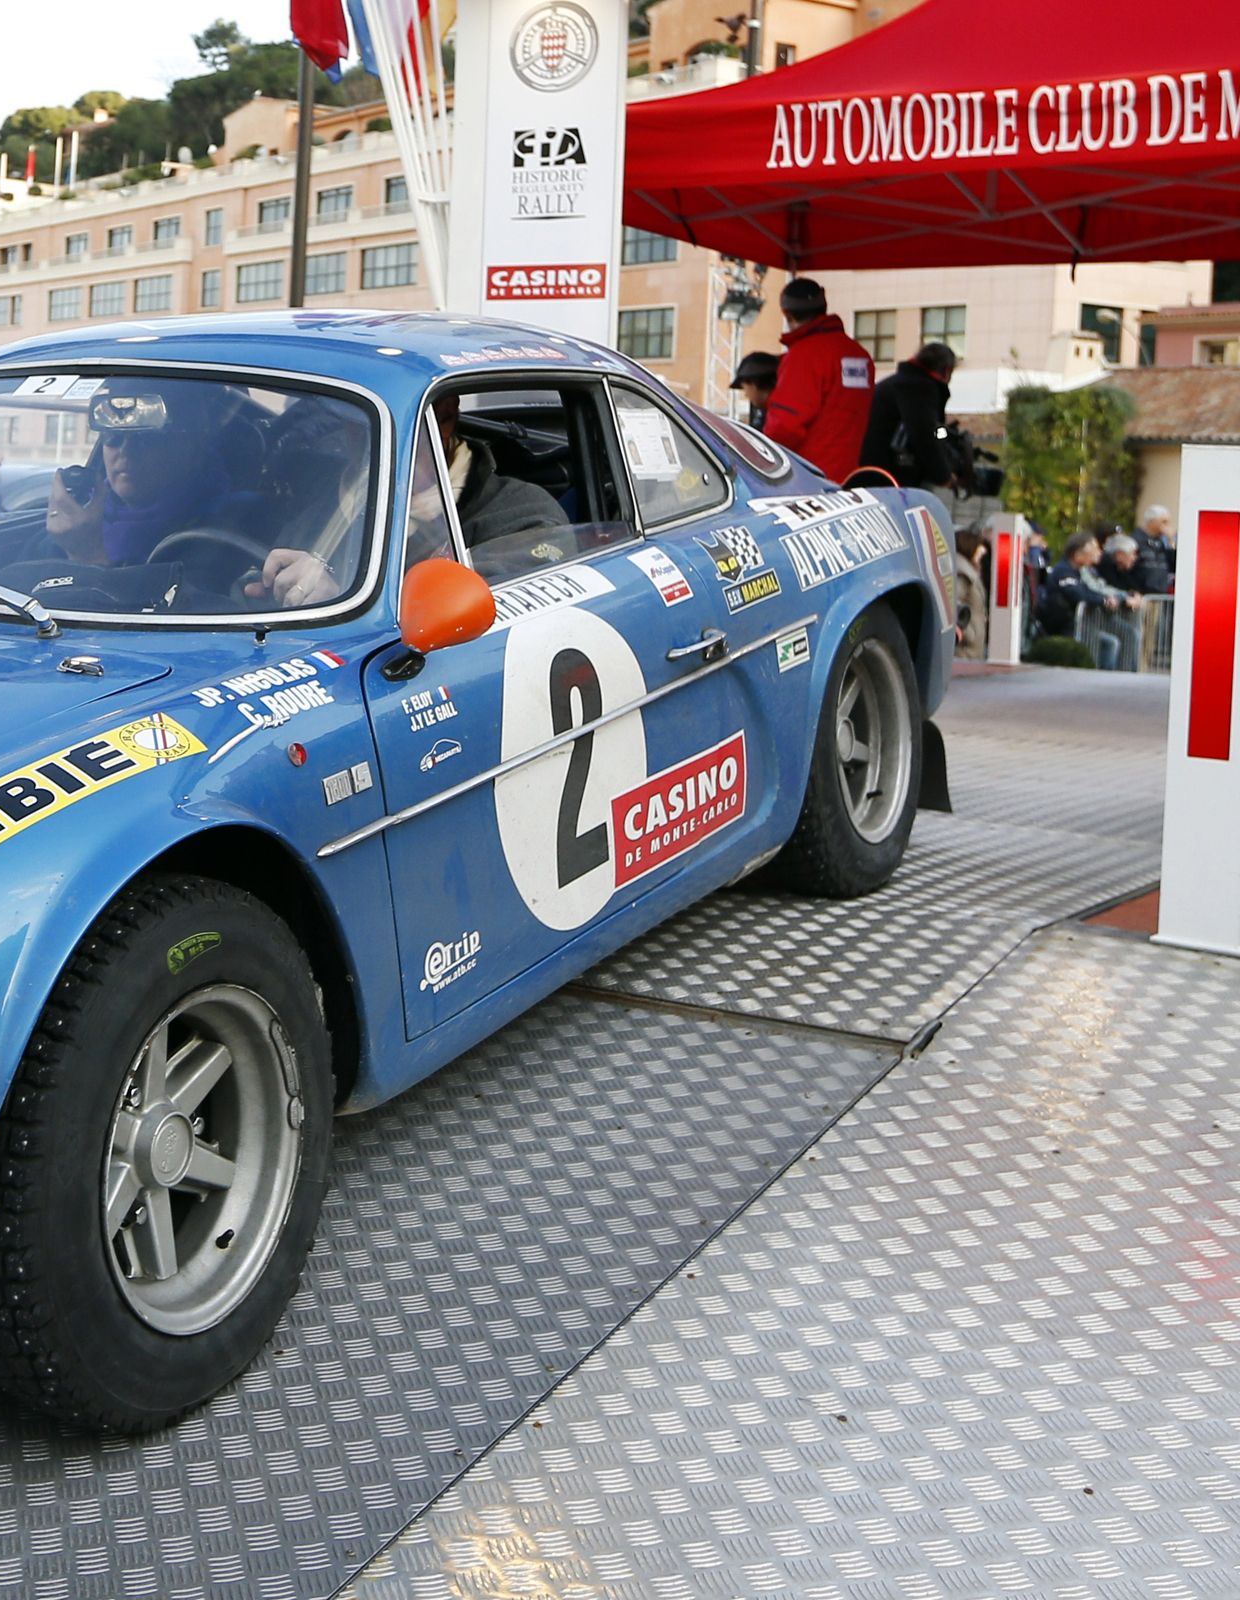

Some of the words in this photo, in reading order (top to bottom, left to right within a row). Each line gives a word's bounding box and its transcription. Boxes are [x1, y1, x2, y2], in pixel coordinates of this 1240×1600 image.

[766, 89, 1020, 169] AUTOMOBILE
[1027, 78, 1141, 155] CLUB
[1146, 72, 1208, 146] DE
[512, 168, 588, 184] HISTORIC
[517, 193, 578, 215] RALLY
[491, 268, 602, 287] CASINO
[490, 287, 506, 297] DE
[512, 286, 602, 297] MONTE-CARLO
[33, 377, 58, 394] 2
[785, 522, 855, 588] ALPINE
[741, 573, 779, 602] MARCHAL
[260, 680, 335, 719] ROURE
[401, 698, 413, 715] F.
[411, 690, 434, 712] ELOY
[424, 711, 437, 727] LE
[435, 701, 458, 722] GALL
[154, 743, 187, 757] TEAM
[549, 648, 610, 889] 2
[623, 756, 738, 842] CASINO
[624, 846, 642, 868] DE
[650, 792, 738, 854] MONTE-CARLO
